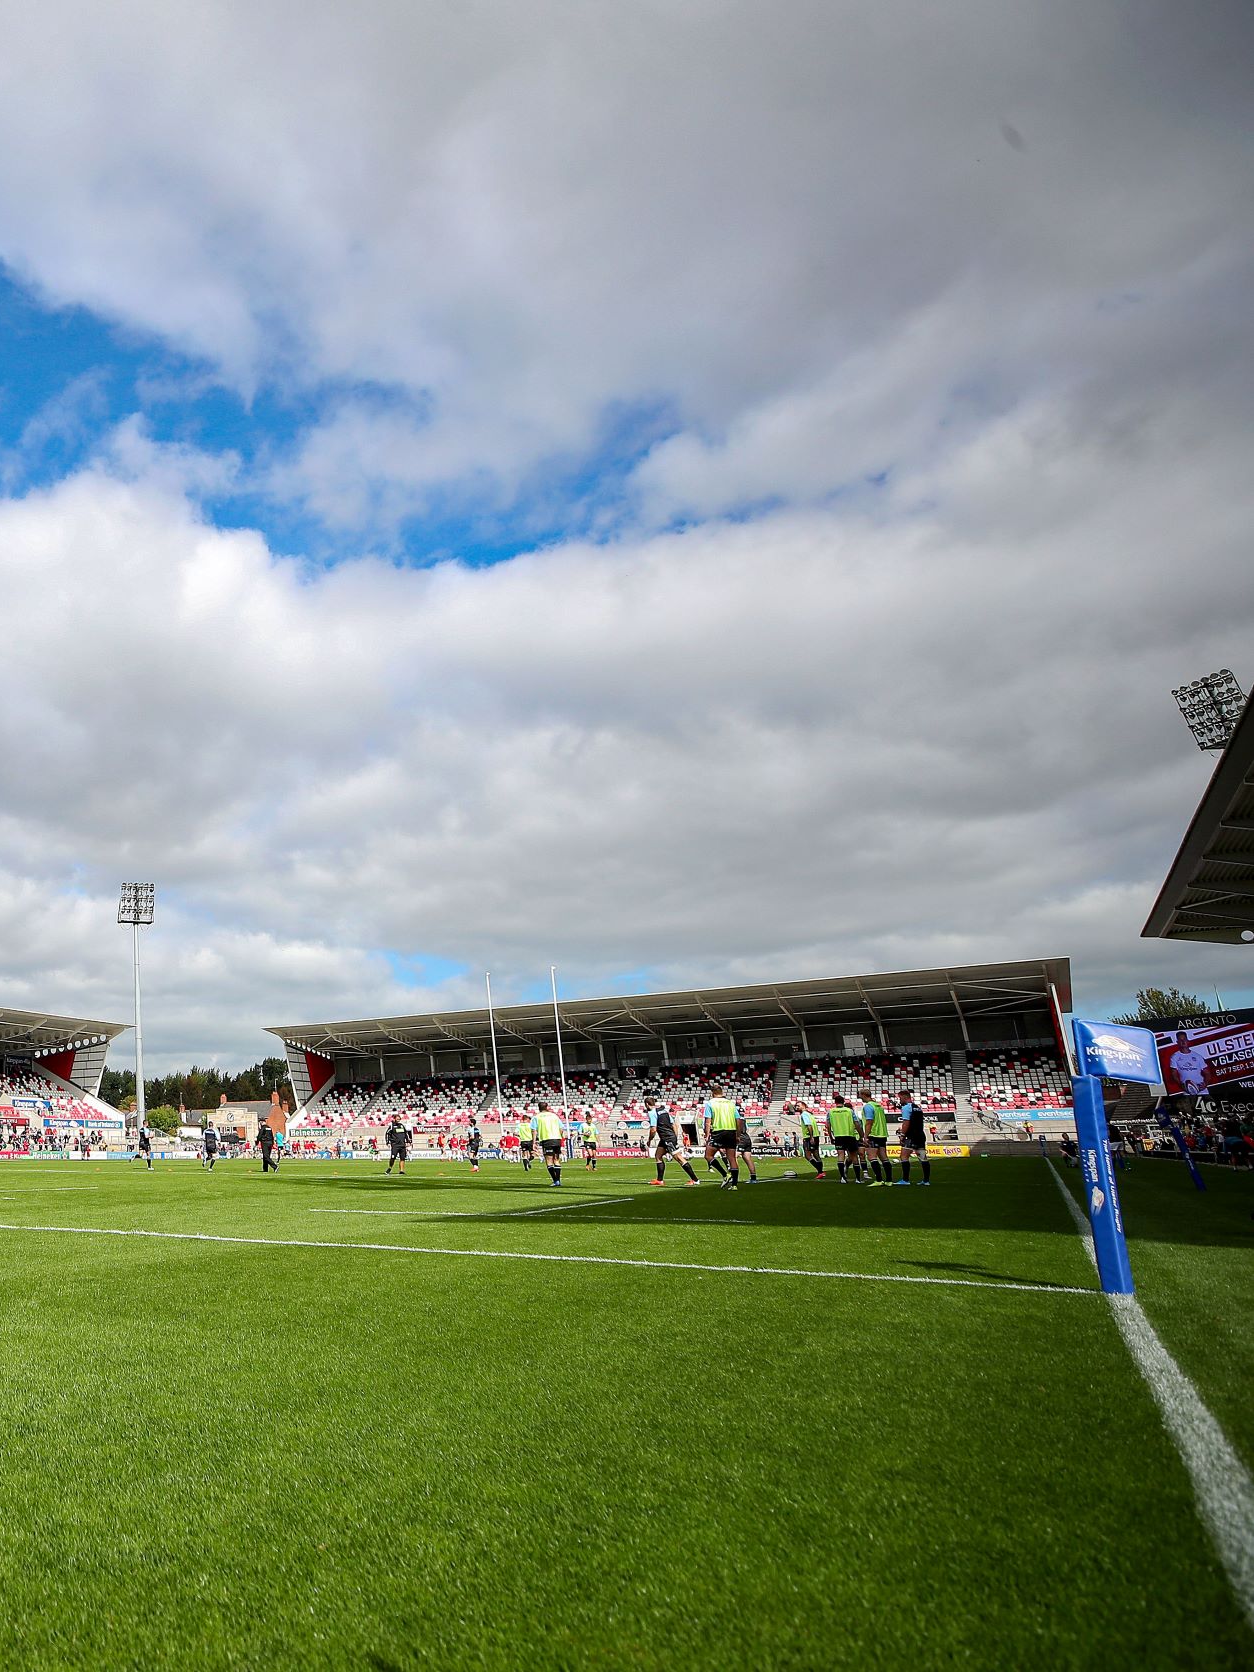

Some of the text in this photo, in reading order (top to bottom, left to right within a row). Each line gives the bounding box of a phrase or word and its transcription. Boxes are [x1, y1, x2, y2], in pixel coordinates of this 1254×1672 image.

[1177, 1014, 1237, 1029] ARGENTO
[1207, 1033, 1254, 1056] ULSTE
[1086, 1047, 1141, 1061] Kingspan
[1216, 1068, 1227, 1076] SAT
[1195, 1096, 1217, 1113] 4c
[995, 1110, 1031, 1118] ventsec
[1037, 1109, 1074, 1118] eventsec
[290, 1129, 324, 1137] Heineken
[33, 1152, 61, 1160] Heineken
[1087, 1149, 1099, 1183] Kingspan
